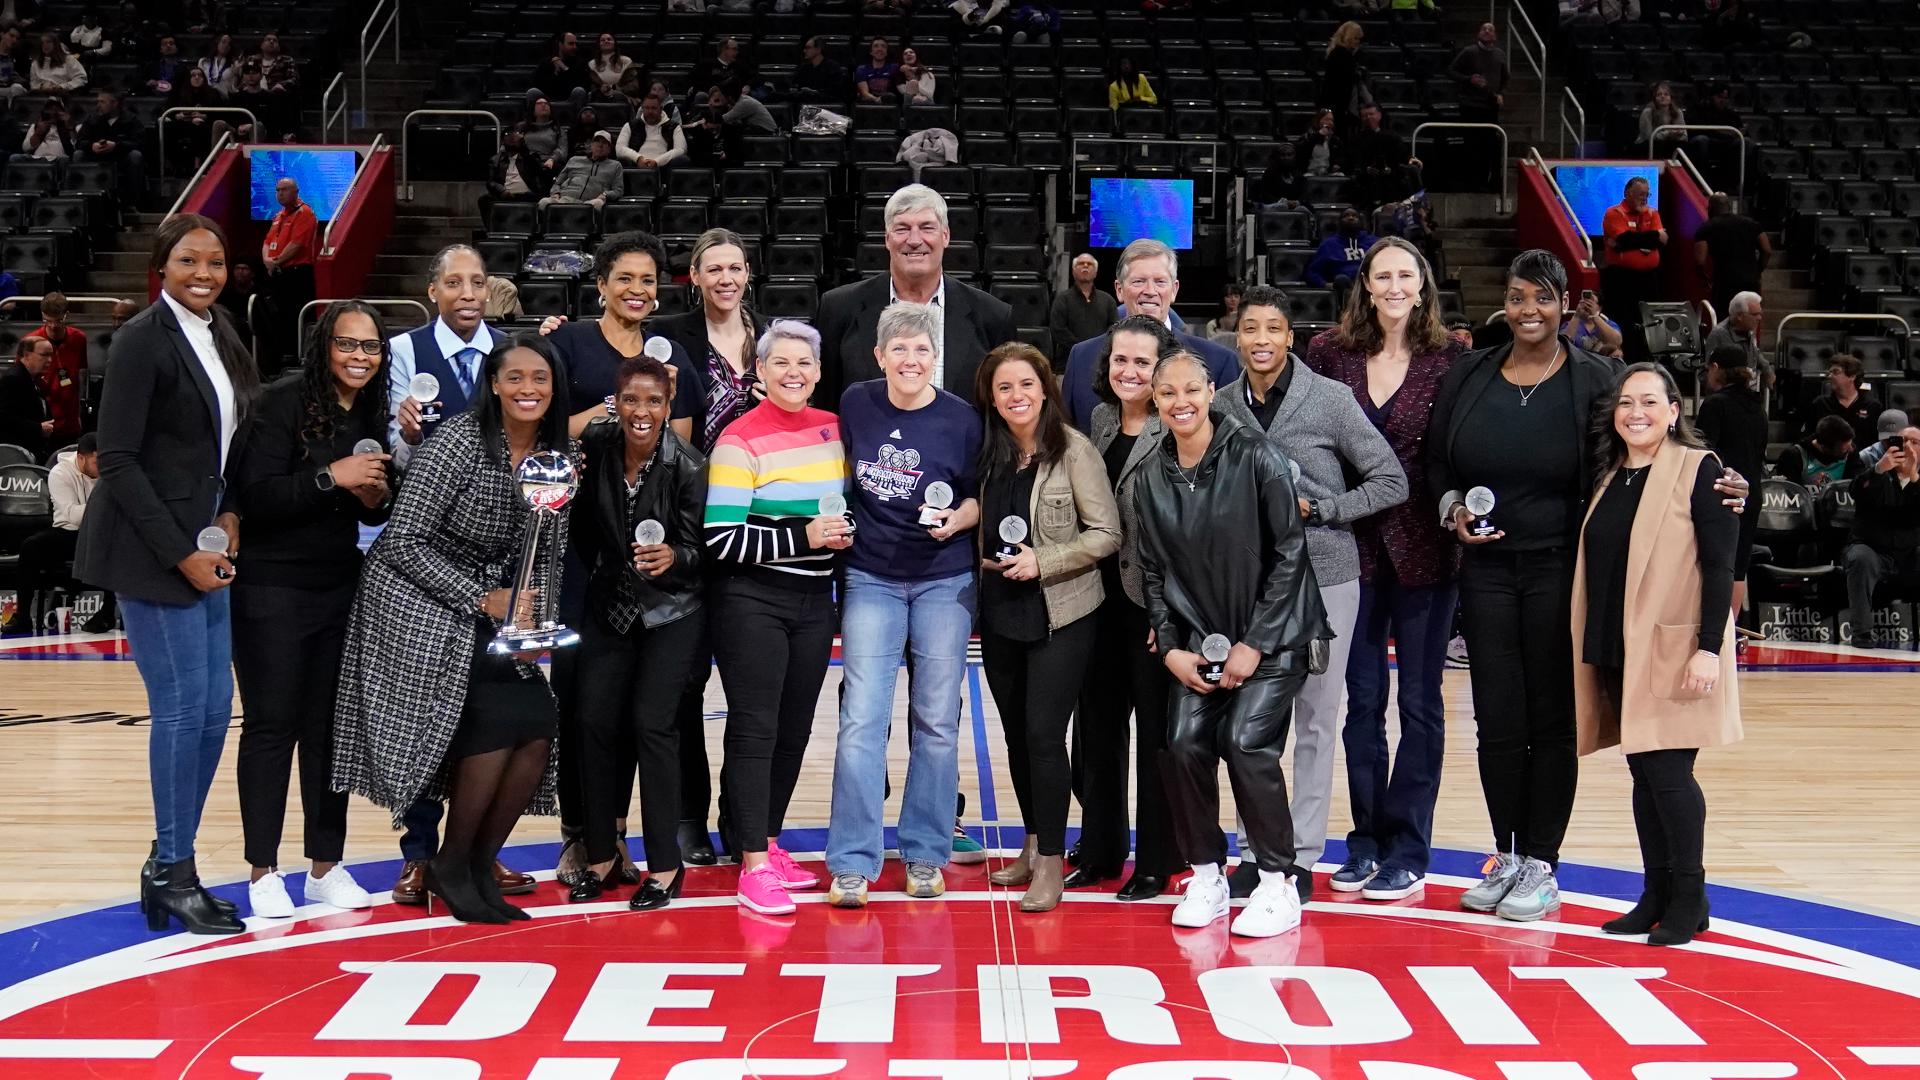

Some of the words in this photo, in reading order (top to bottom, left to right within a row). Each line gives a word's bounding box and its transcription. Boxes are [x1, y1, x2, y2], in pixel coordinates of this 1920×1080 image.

[0, 476, 43, 493] UWM
[1772, 606, 1821, 626] Little
[1760, 621, 1830, 641] Caesars
[1839, 621, 1909, 642] Csars
[314, 961, 1708, 1046] DETROIT
